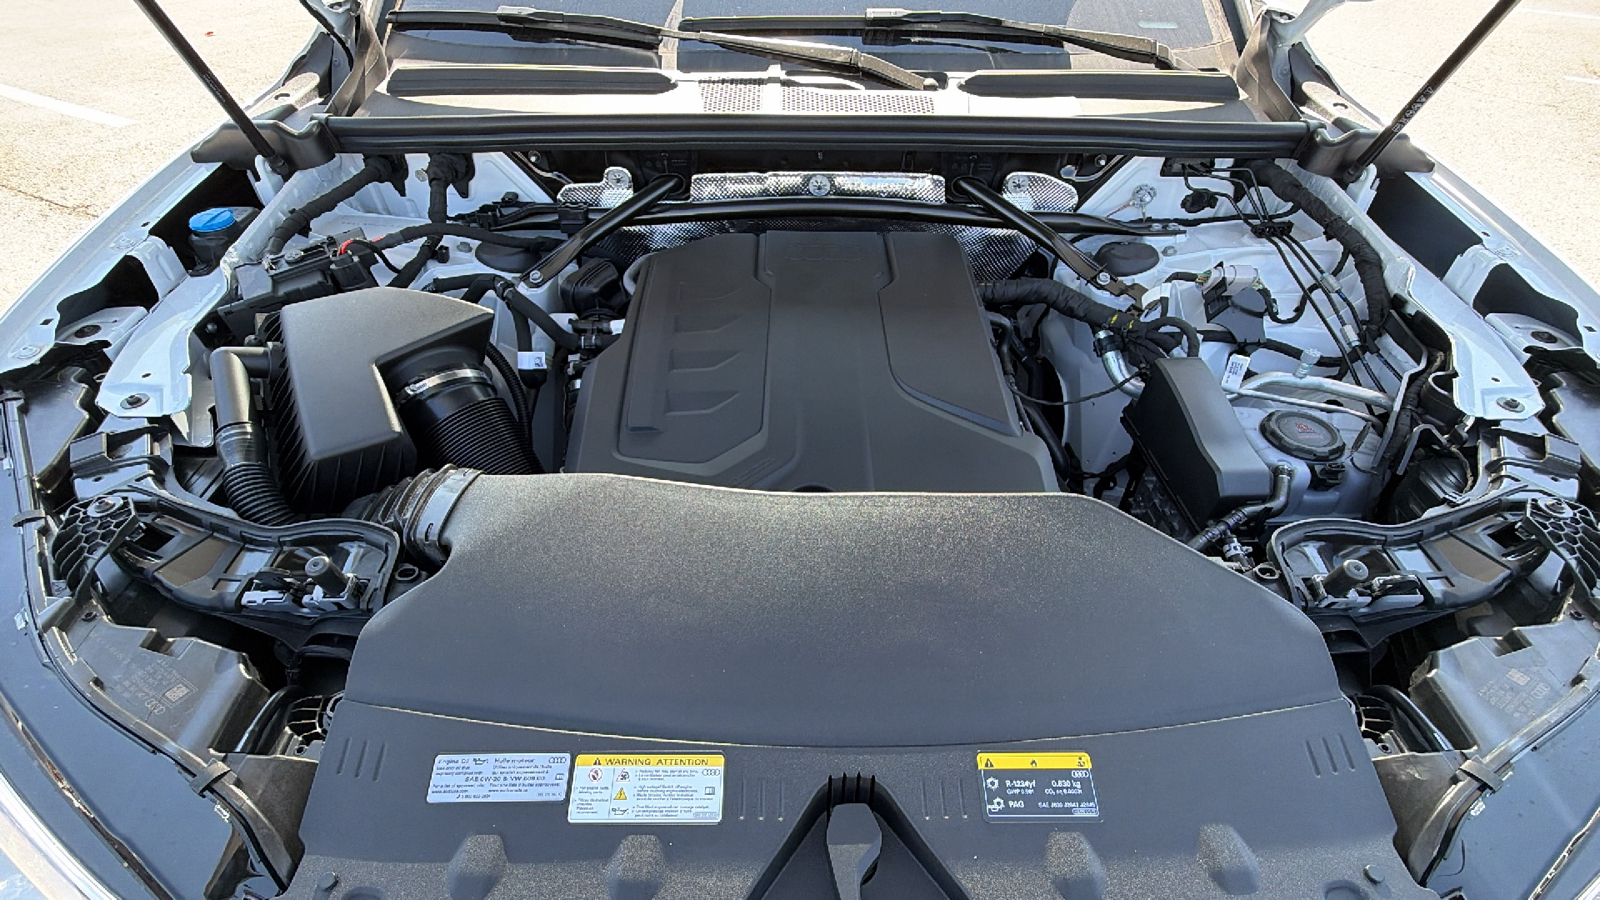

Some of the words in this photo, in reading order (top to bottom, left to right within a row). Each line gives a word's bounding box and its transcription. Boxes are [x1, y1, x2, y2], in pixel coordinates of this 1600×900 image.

[604, 758, 652, 766] WARNING
[656, 758, 709, 766] ATTENTION
[1008, 800, 1025, 808] PAG
